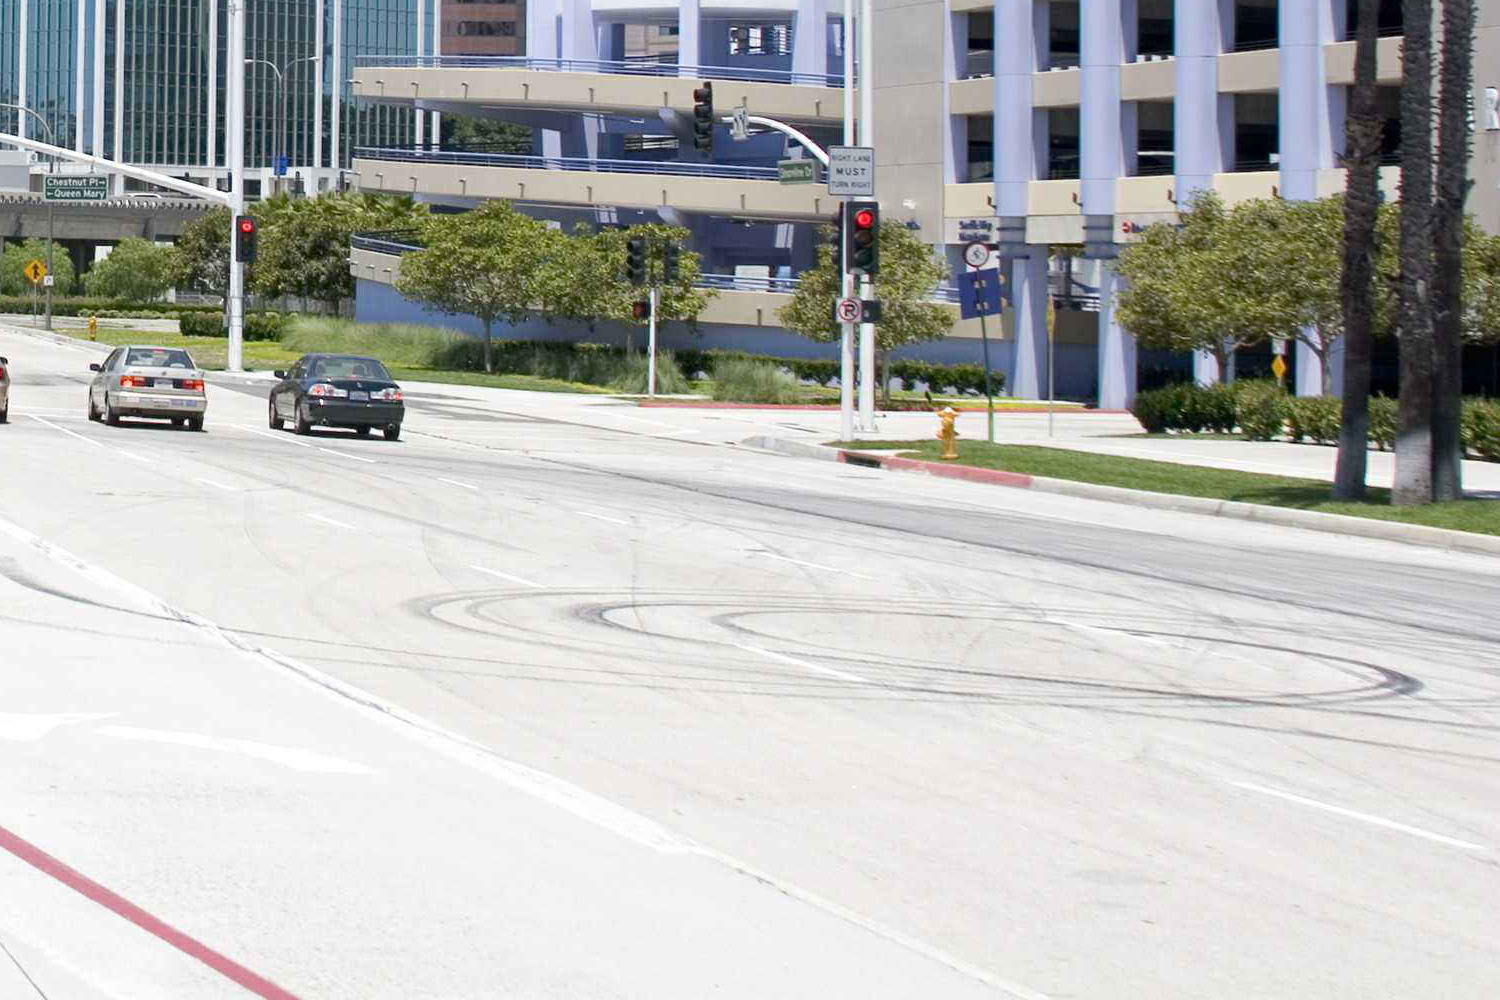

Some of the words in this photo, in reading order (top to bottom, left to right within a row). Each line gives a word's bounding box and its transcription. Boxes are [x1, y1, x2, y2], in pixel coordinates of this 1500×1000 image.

[832, 154, 851, 162] RIGHT
[836, 167, 867, 176] MUST
[47, 178, 88, 186] Chestnut
[89, 178, 99, 186] Pl
[851, 181, 871, 189] RIGHT
[54, 189, 82, 198] Queen
[83, 189, 106, 200] Mary
